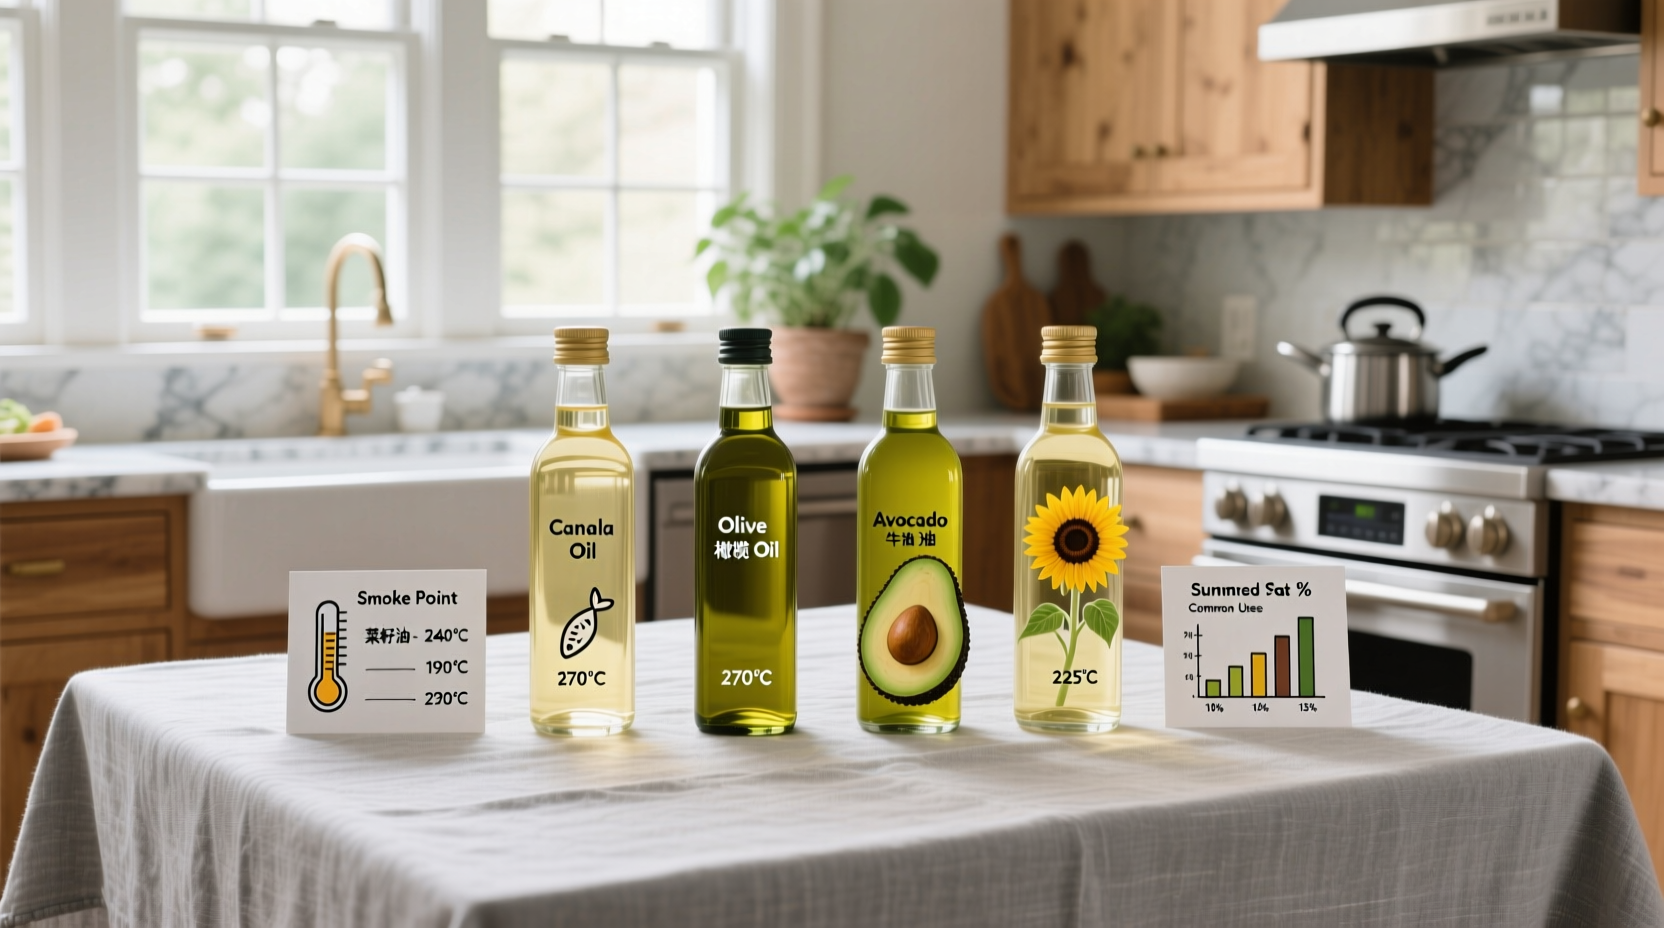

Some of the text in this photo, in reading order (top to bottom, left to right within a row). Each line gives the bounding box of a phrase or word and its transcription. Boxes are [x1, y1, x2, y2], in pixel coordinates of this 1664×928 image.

[717, 515, 768, 534] Olive
[872, 510, 948, 528] Avocado
[569, 541, 597, 560] Oil
[753, 540, 779, 558] Oil
[356, 589, 459, 606] Smoke Point
[1296, 581, 1312, 598] %
[424, 627, 469, 643] 240°C
[425, 659, 469, 675] 190°C
[557, 670, 607, 687] 270°C
[720, 668, 773, 687] 270°C
